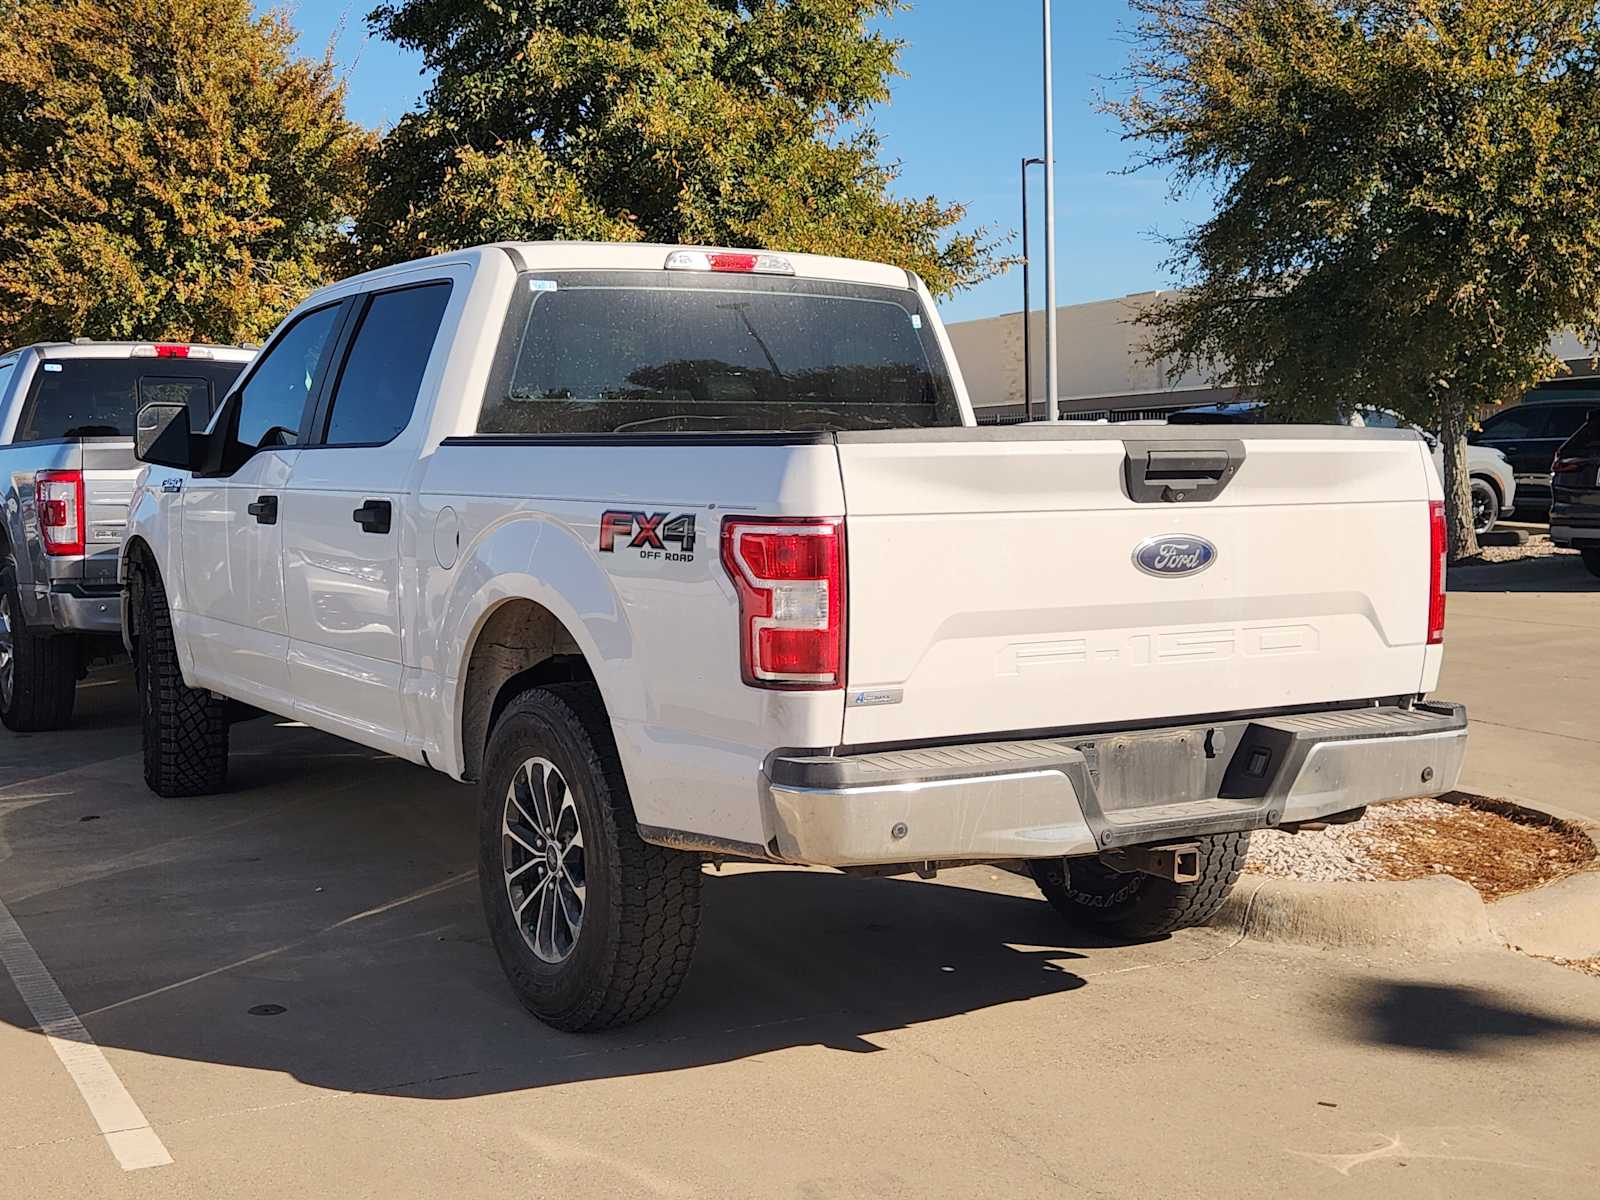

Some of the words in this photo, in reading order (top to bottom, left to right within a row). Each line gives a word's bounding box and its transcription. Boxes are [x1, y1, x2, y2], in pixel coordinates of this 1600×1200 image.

[599, 509, 697, 552] FX4
[640, 550, 661, 560] OFF
[665, 552, 694, 562] ROAD
[1154, 543, 1200, 568] Ford
[994, 624, 1320, 677] F-150
